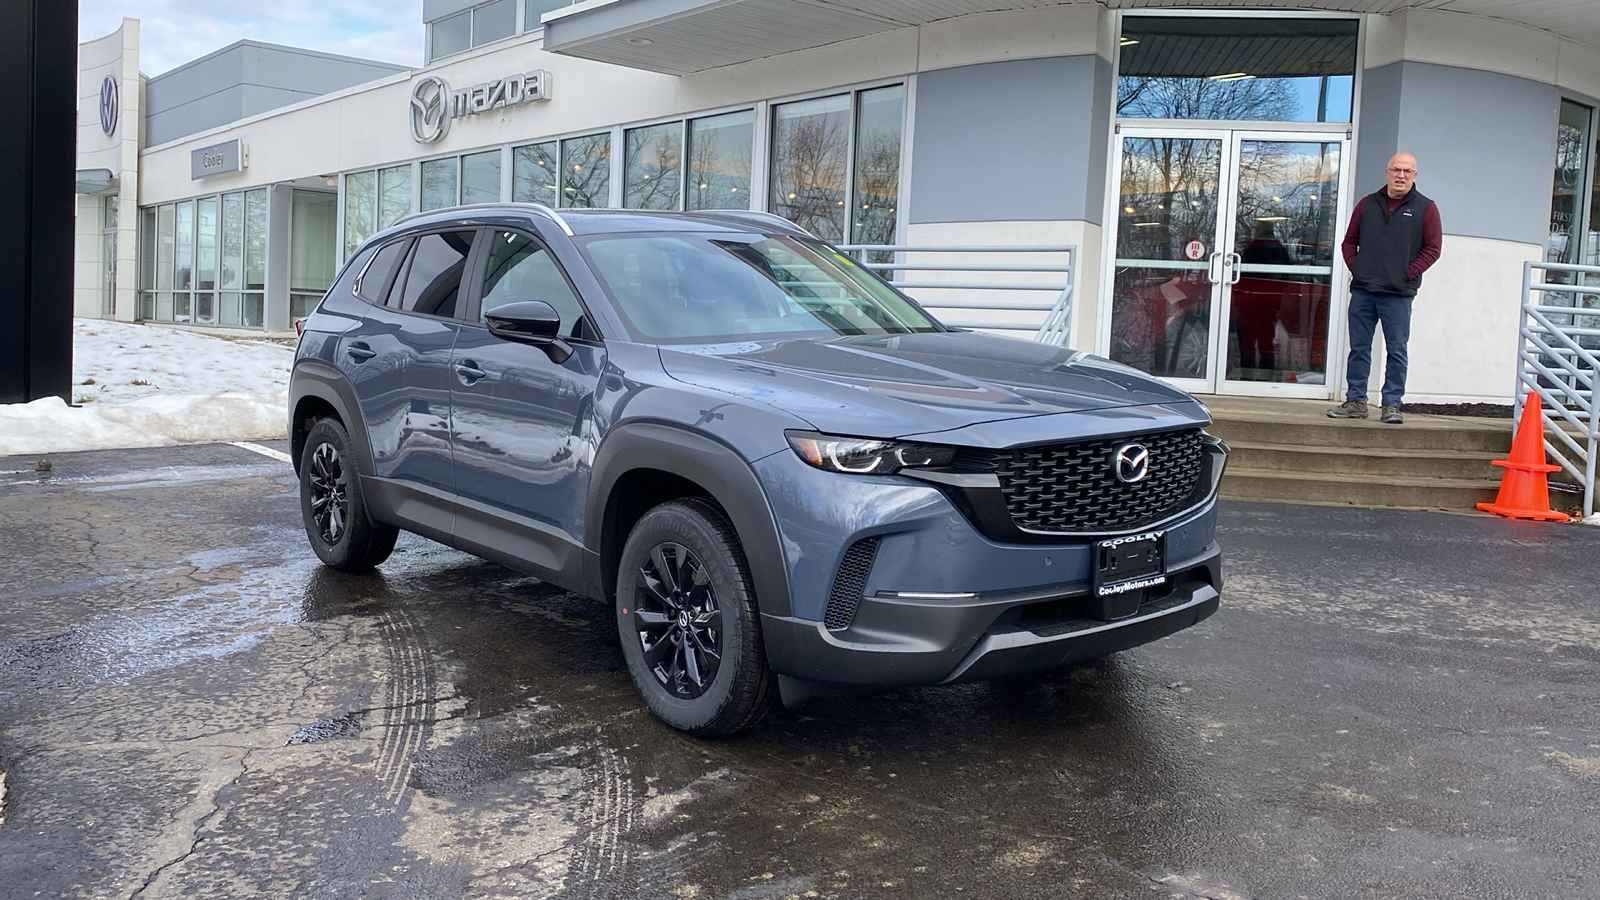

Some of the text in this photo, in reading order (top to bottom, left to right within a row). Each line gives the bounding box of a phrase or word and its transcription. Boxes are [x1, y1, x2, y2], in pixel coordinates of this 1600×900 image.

[451, 69, 548, 118] mazda
[203, 149, 225, 169] Cooley
[1192, 250, 1198, 258] R
[1101, 531, 1165, 548] COOLEY
[1098, 576, 1166, 596] CooleyMotors.com
